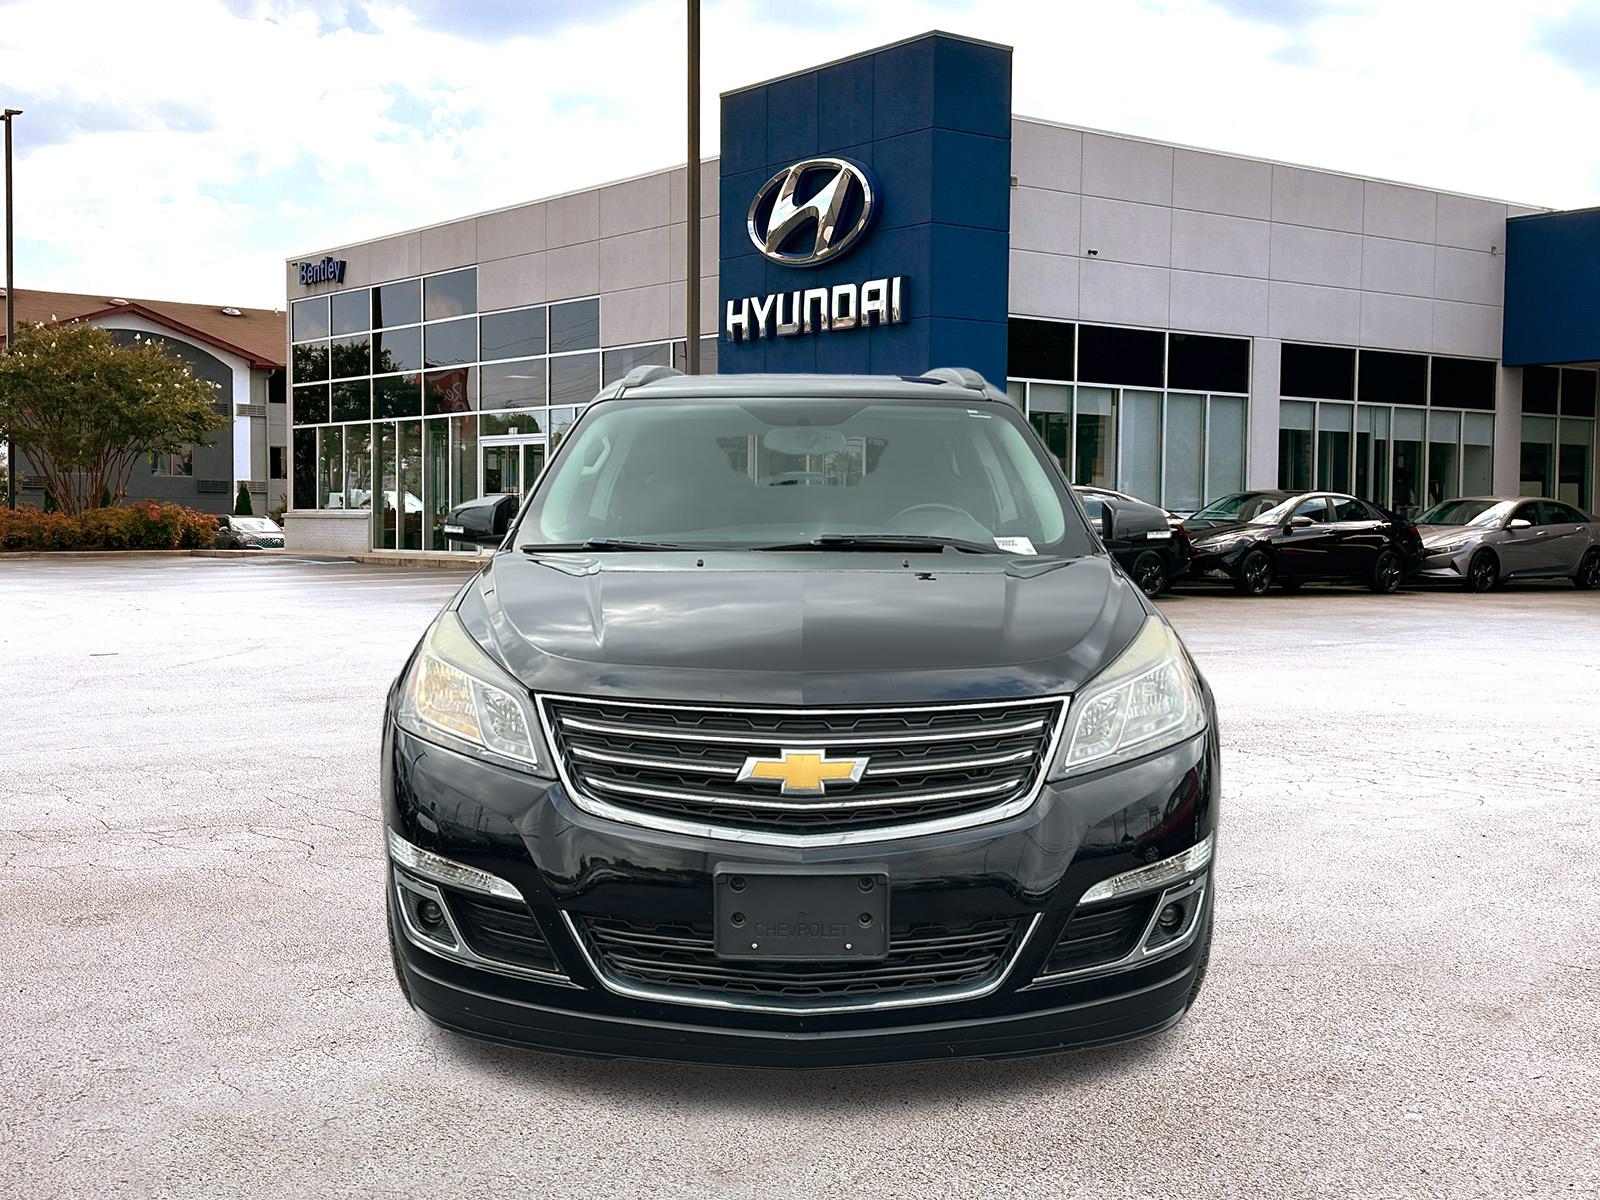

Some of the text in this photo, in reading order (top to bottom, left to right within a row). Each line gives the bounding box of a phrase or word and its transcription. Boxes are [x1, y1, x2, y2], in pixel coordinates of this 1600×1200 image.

[299, 256, 344, 285] Bentley
[726, 276, 903, 341] HYUNDAI
[754, 922, 849, 938] CHEVROLET
